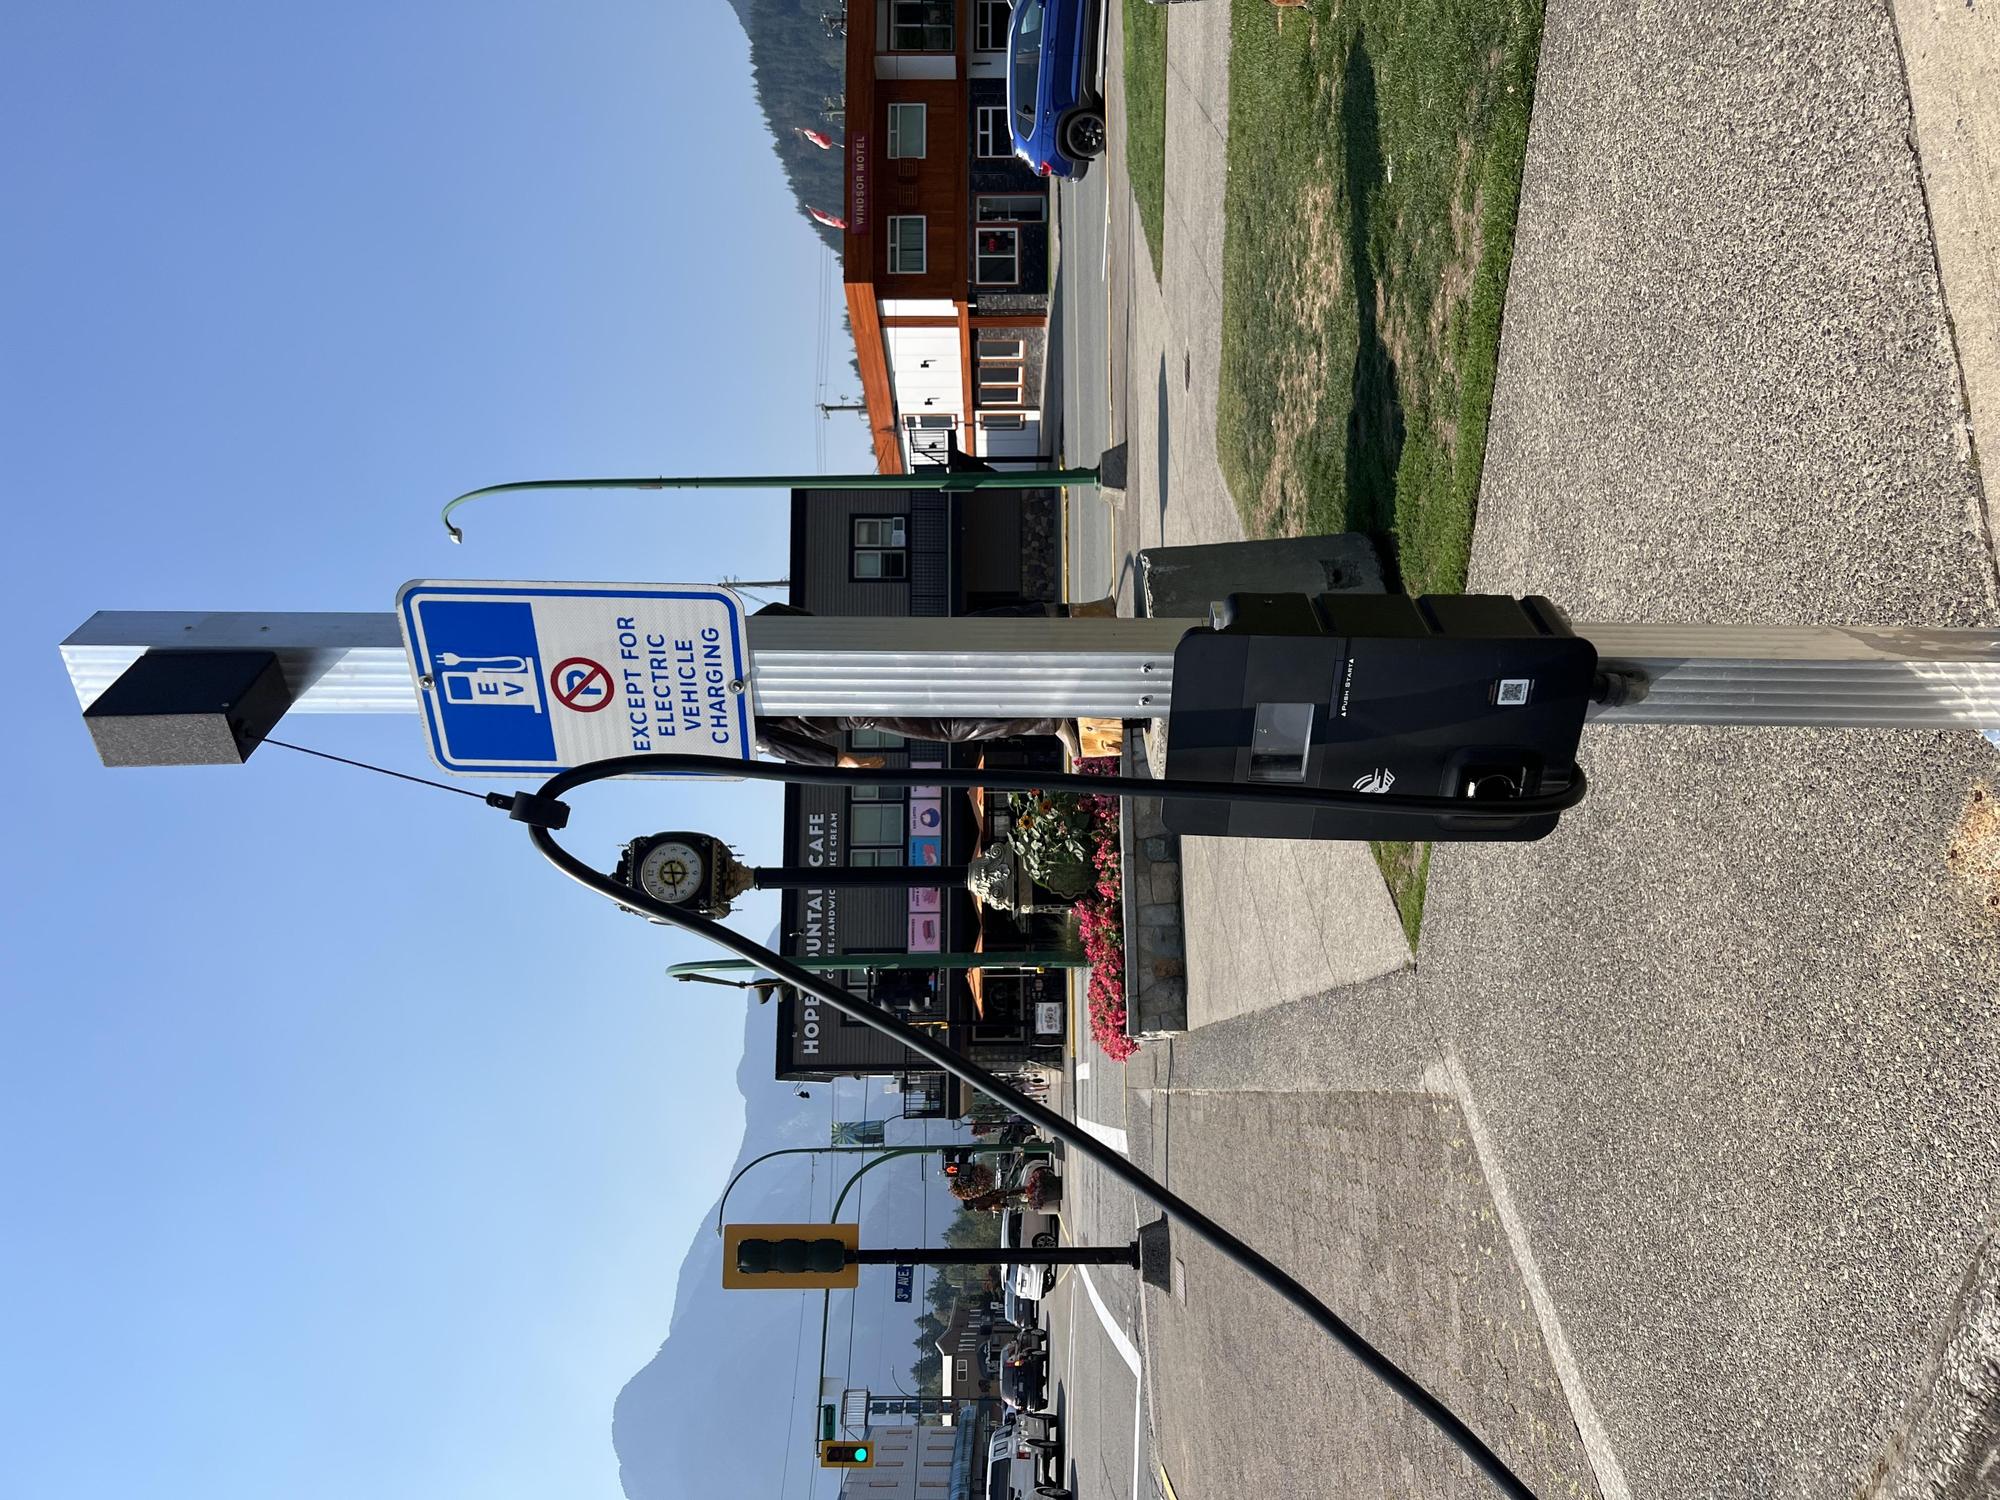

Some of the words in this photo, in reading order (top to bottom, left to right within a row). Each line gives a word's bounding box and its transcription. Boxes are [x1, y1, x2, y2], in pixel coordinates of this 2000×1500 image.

[856, 136, 865, 171] MOTEL
[856, 175, 865, 225] WINDSOR
[616, 617, 639, 660] FOR
[567, 670, 601, 695] P
[624, 668, 651, 751] EXCEPT
[647, 634, 676, 736] ELECTRIC
[675, 640, 701, 730] VEHICLE
[702, 628, 729, 744] CHARGING
[808, 814, 824, 867] CAFE
[806, 889, 822, 974] UNTAI
[828, 889, 836, 936] SANDWIC
[803, 995, 820, 1054] HOPE
